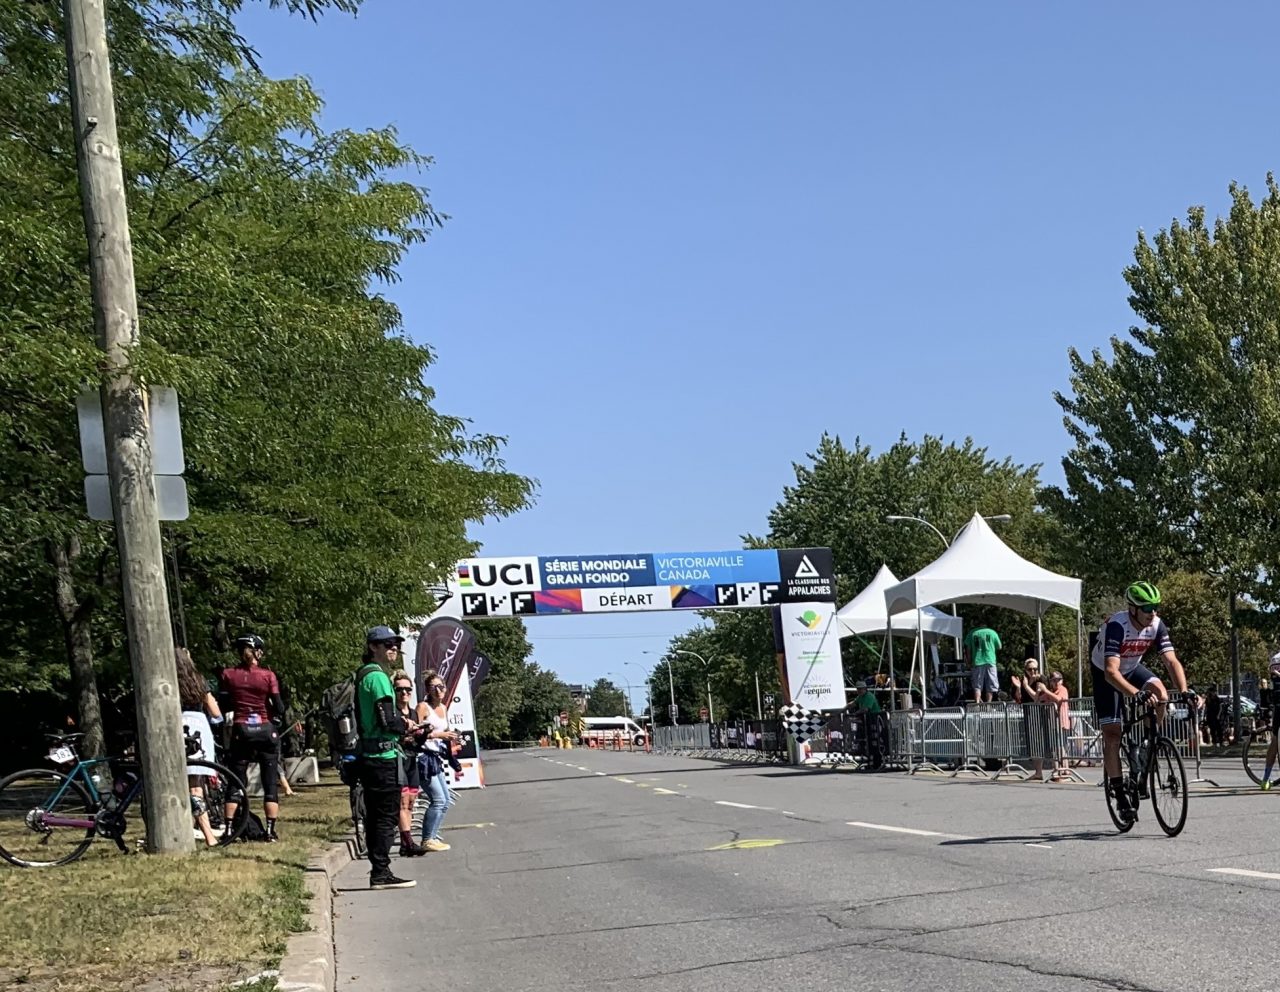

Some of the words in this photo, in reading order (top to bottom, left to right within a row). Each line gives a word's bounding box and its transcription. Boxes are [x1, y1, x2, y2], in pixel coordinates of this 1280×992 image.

[544, 560, 579, 572] SÉRIE
[581, 559, 647, 571] MONDIALE
[657, 555, 744, 569] VICTORIAVILLE
[472, 563, 534, 587] UCI
[546, 574, 583, 585] GRAN
[585, 572, 630, 584] FONDO
[658, 569, 711, 581] CANADA
[788, 585, 831, 596] APPALACHES
[599, 592, 654, 607] DÉPART
[437, 626, 464, 680] EXUS
